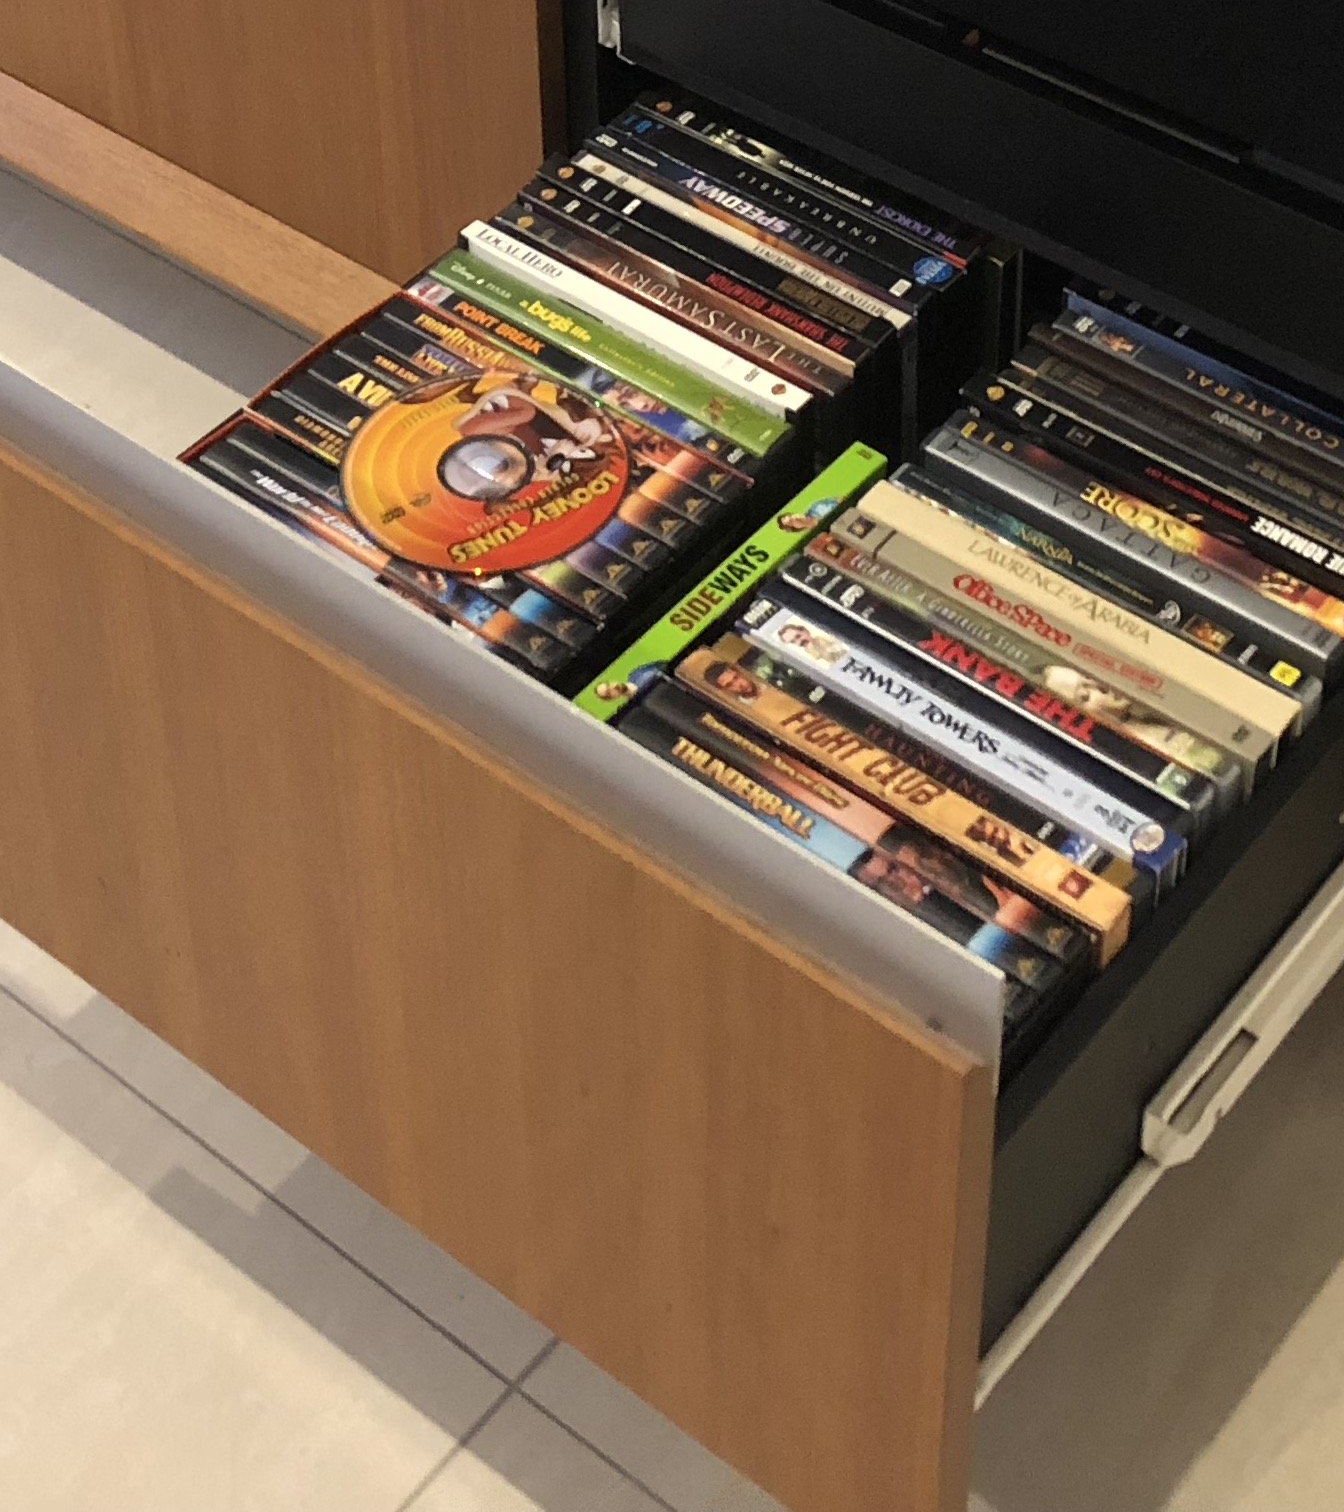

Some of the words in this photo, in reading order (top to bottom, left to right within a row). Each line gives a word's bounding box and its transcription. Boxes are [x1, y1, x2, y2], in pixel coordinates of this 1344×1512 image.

[679, 176, 792, 234] SPEEDWAY
[736, 170, 877, 245] UNBREAKABLE
[475, 228, 524, 261] LOCAL
[521, 252, 563, 280] HERO
[607, 261, 725, 329] SAMURAI
[453, 301, 499, 328] POINT
[495, 323, 545, 355] BREAK
[721, 321, 786, 363] LAST
[337, 372, 364, 393] A
[1185, 368, 1340, 450] COLLATERAL
[532, 471, 620, 526] LOONEY
[1080, 480, 1183, 539] SCORE
[449, 519, 529, 564] TUNES
[1053, 491, 1211, 584] GATTACA
[1249, 515, 1329, 565] ROMANCE
[669, 544, 771, 633] SIDEWAYS
[967, 539, 1069, 599] LAWRENCE
[1073, 597, 1151, 645] ARABIA
[917, 630, 1025, 699] BANK
[840, 656, 923, 708] FAWLTY
[919, 700, 1003, 754] TOWERS
[1022, 688, 1098, 744] THE
[671, 735, 815, 839] THUNDERBALL
[779, 708, 875, 762] FIGHT
[862, 754, 949, 807] CLUB
